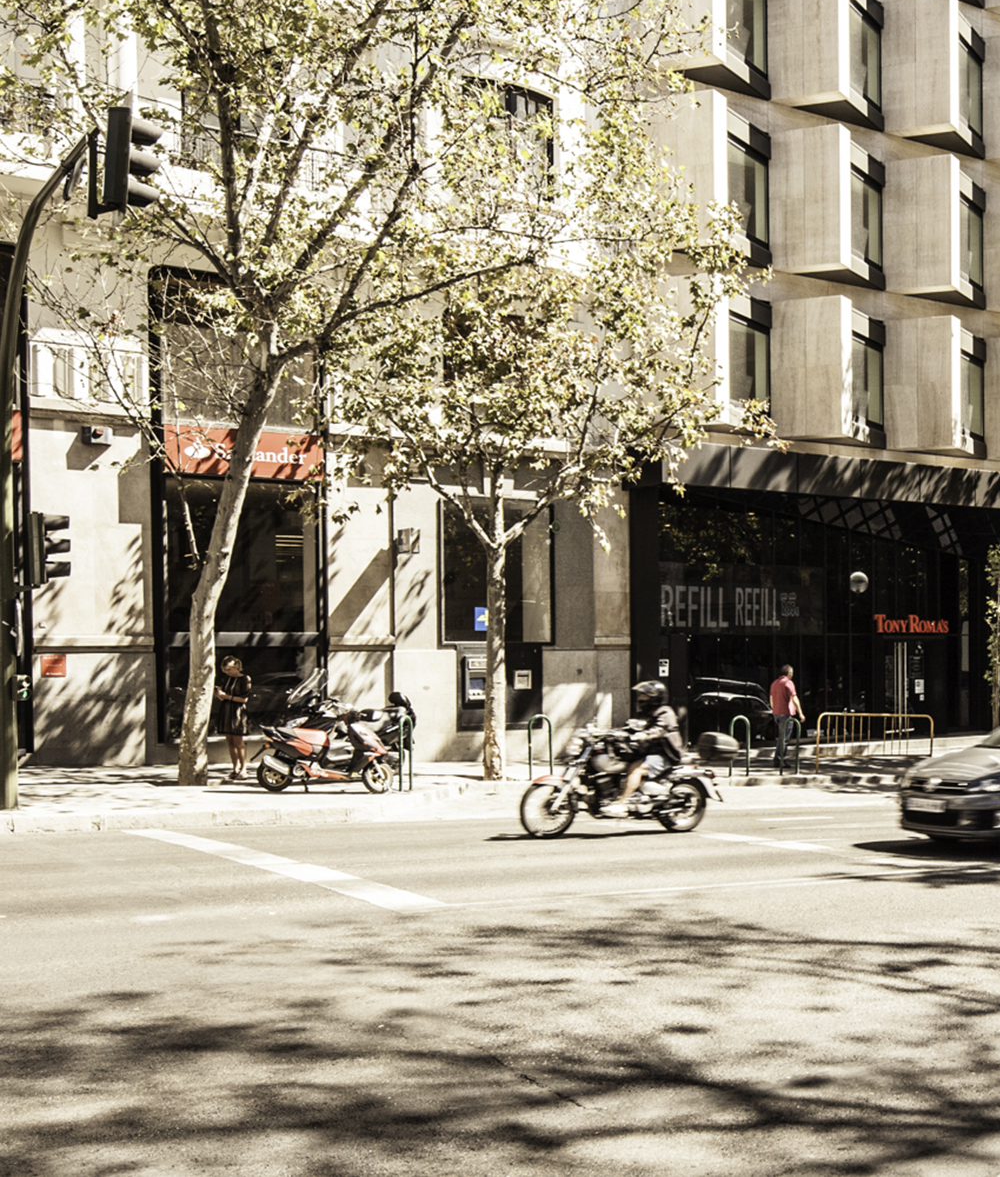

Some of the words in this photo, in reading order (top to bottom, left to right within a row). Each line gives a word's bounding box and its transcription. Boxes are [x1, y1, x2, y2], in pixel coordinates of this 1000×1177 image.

[214, 443, 307, 465] Saander
[660, 584, 729, 628] REFILL
[735, 587, 781, 626] REFILL
